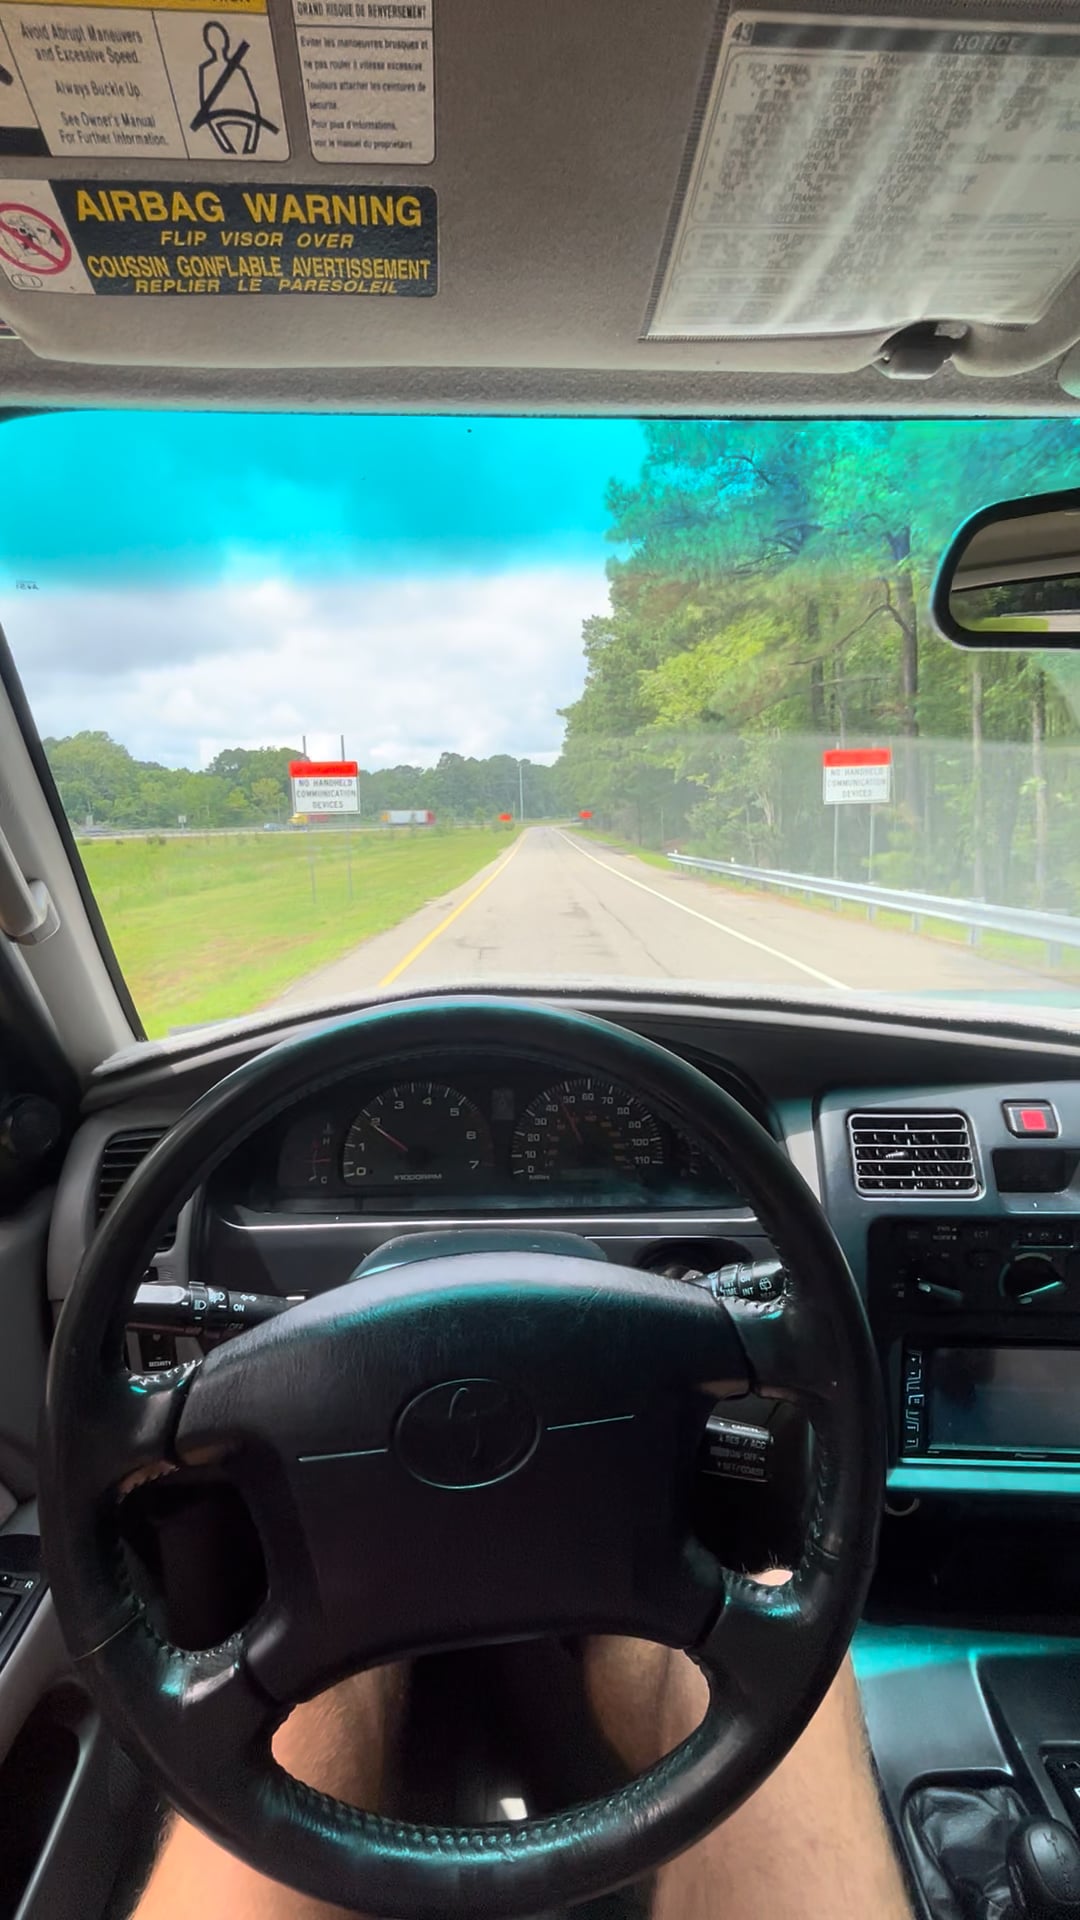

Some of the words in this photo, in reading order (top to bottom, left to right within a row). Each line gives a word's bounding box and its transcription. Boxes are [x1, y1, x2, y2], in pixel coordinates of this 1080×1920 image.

[297, 2, 324, 17] GRAND
[326, 3, 353, 18] RISQUE
[355, 4, 365, 18] DE
[20, 20, 49, 40] Avoid
[51, 23, 87, 44] Abrupt
[87, 24, 144, 44] Maneuvers
[952, 34, 1021, 50] NOTICE
[35, 47, 53, 61] and
[55, 45, 105, 63] Excessive
[106, 47, 141, 67] Speed.
[55, 80, 91, 99] Always
[91, 80, 125, 97] Buckle
[125, 81, 143, 99] Up.
[60, 111, 79, 127] See
[80, 111, 119, 127] Owner's
[120, 112, 156, 129] Manual
[58, 129, 76, 145] For
[78, 130, 111, 146] Further
[112, 131, 169, 147] Information.
[76, 189, 226, 223] AIRBAG
[242, 191, 422, 227] WARNING
[160, 230, 208, 247] FLIP
[220, 231, 284, 247] VISOR
[296, 233, 355, 249] OVER
[86, 255, 172, 279] COUSSIN
[176, 255, 284, 279] GONFLABLE
[292, 255, 431, 281] AVERTISSEMENT
[135, 279, 221, 293] REPLIER
[238, 279, 262, 293] LE
[278, 279, 399, 294] PARESOLEIL
[298, 778, 310, 787] NO
[312, 778, 353, 787] HANDHELD
[296, 790, 356, 798] COMMUNICATION
[312, 800, 344, 809] DEVICES
[394, 1100, 405, 1110] 3
[422, 1097, 432, 1105] 4
[601, 1097, 614, 1105] 70
[450, 1107, 460, 1117] 5
[546, 1104, 558, 1113] 40
[534, 1117, 547, 1126] 30
[527, 1133, 540, 1142] 20
[632, 1138, 649, 1147] 100
[525, 1150, 537, 1159] 10
[468, 1160, 480, 1170] 7
[634, 1156, 650, 1165] 110
[356, 1167, 367, 1176] 0
[741, 1287, 754, 1296] INT
[233, 1303, 245, 1312] ON
[24, 1579, 34, 1589] R
